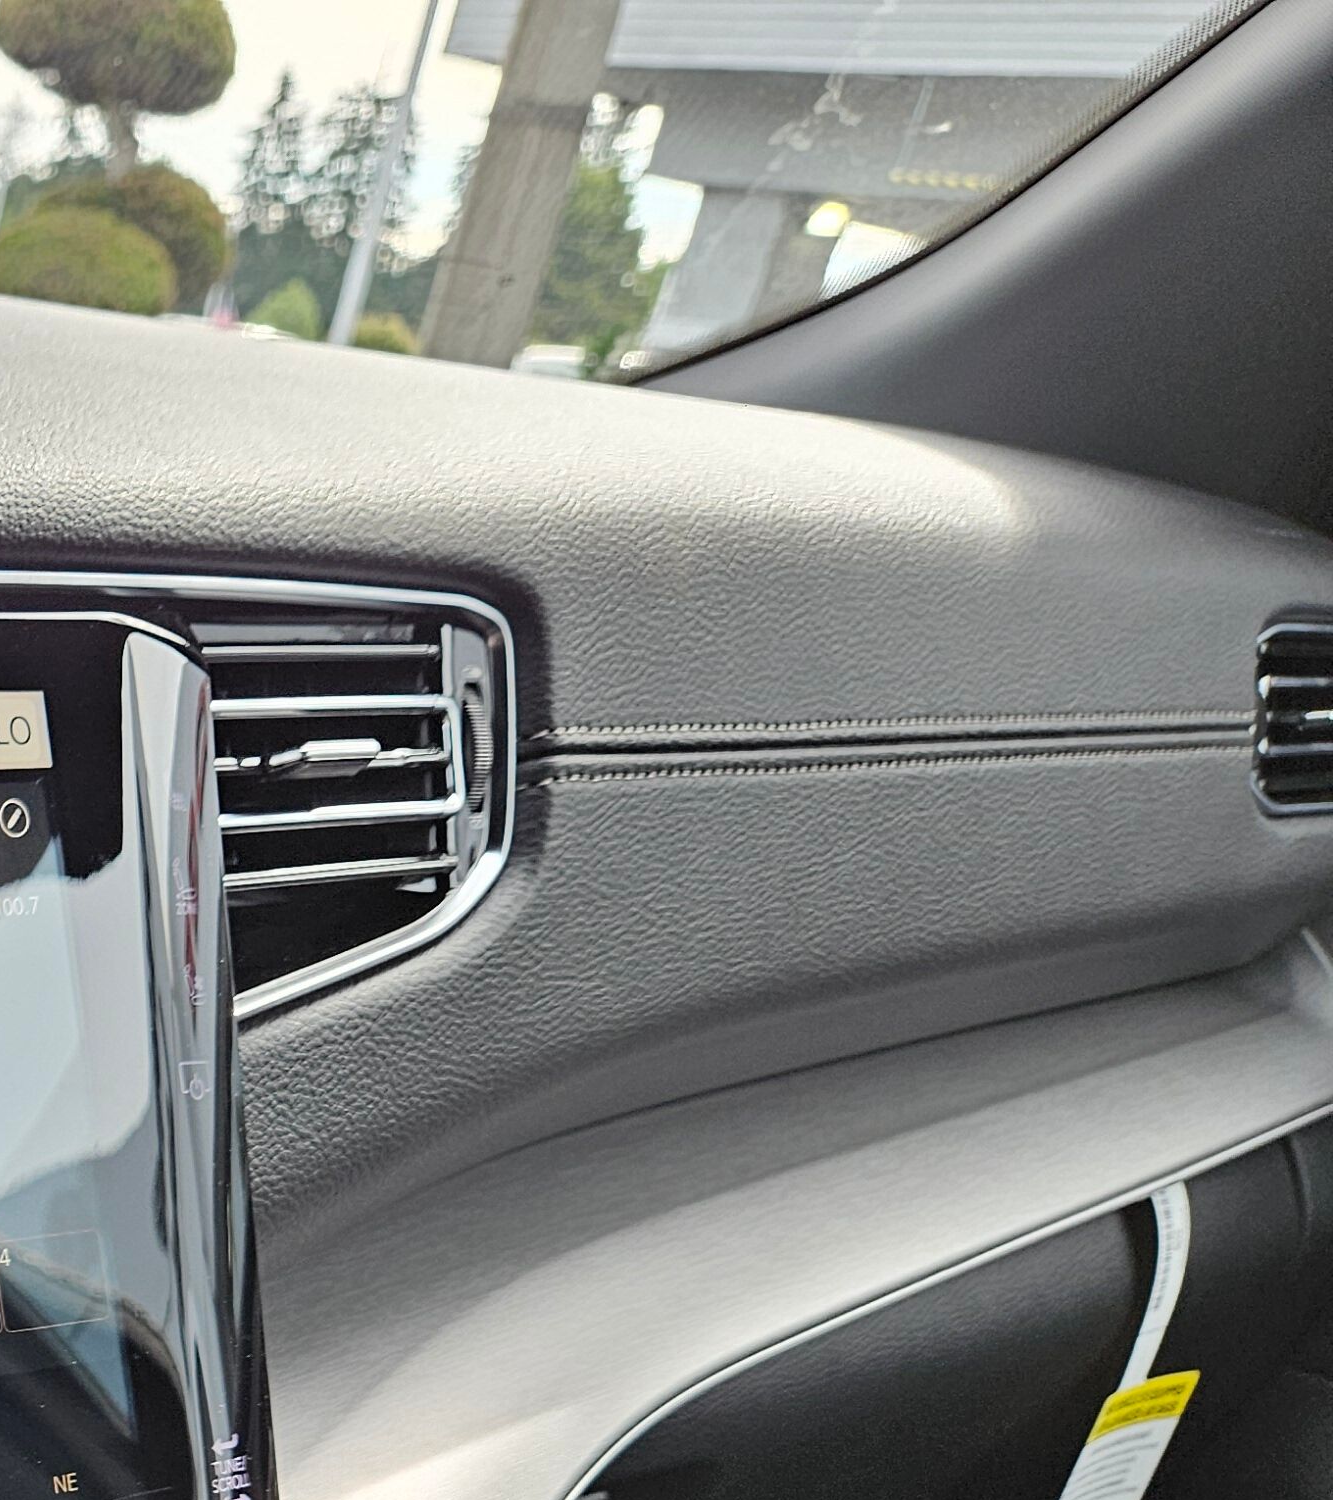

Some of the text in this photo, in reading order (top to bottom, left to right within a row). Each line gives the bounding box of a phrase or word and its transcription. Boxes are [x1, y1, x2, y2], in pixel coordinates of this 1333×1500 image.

[0, 1248, 12, 1266] 4
[53, 1474, 77, 1493] NE
[212, 1473, 252, 1493] SCROLL
